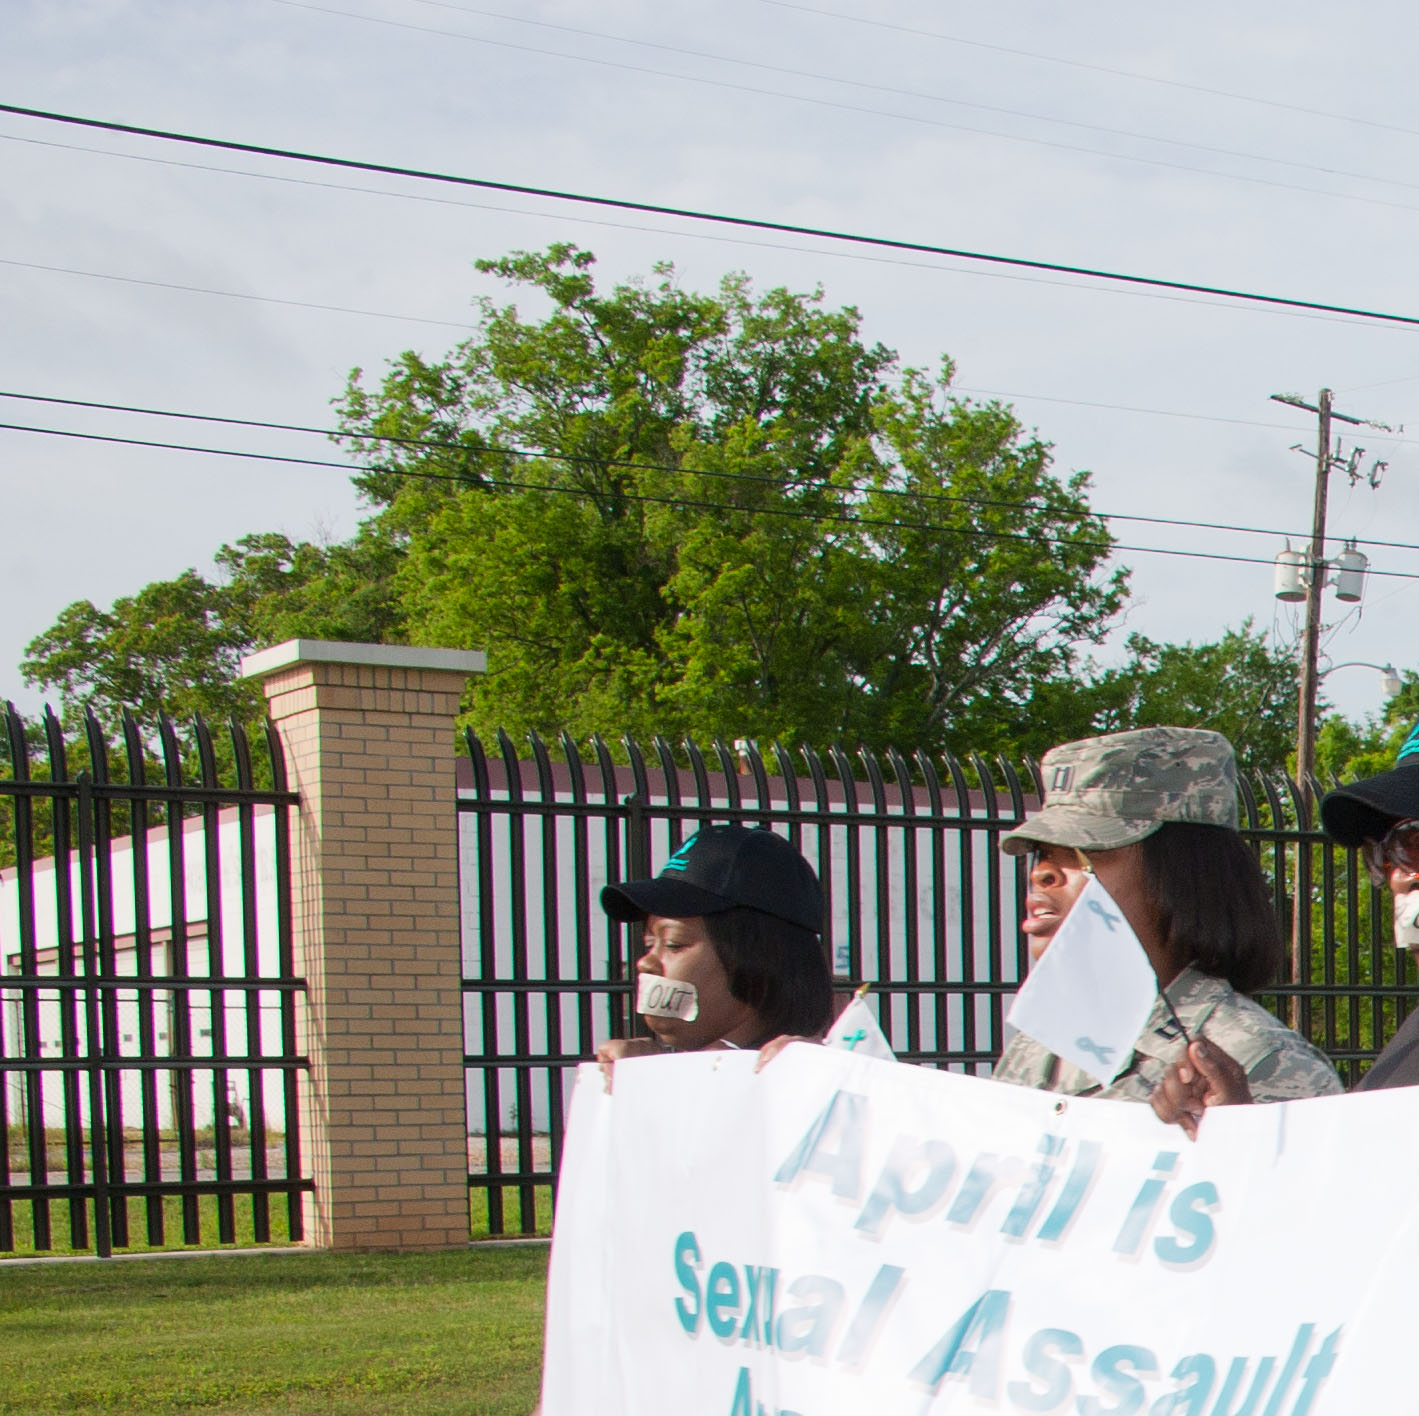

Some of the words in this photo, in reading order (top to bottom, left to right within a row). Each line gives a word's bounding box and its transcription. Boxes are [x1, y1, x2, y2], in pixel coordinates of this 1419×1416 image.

[647, 984, 694, 1012] OUT
[773, 1089, 1102, 1241] April
[1112, 1150, 1220, 1264] is
[674, 1231, 907, 1366] Sexual
